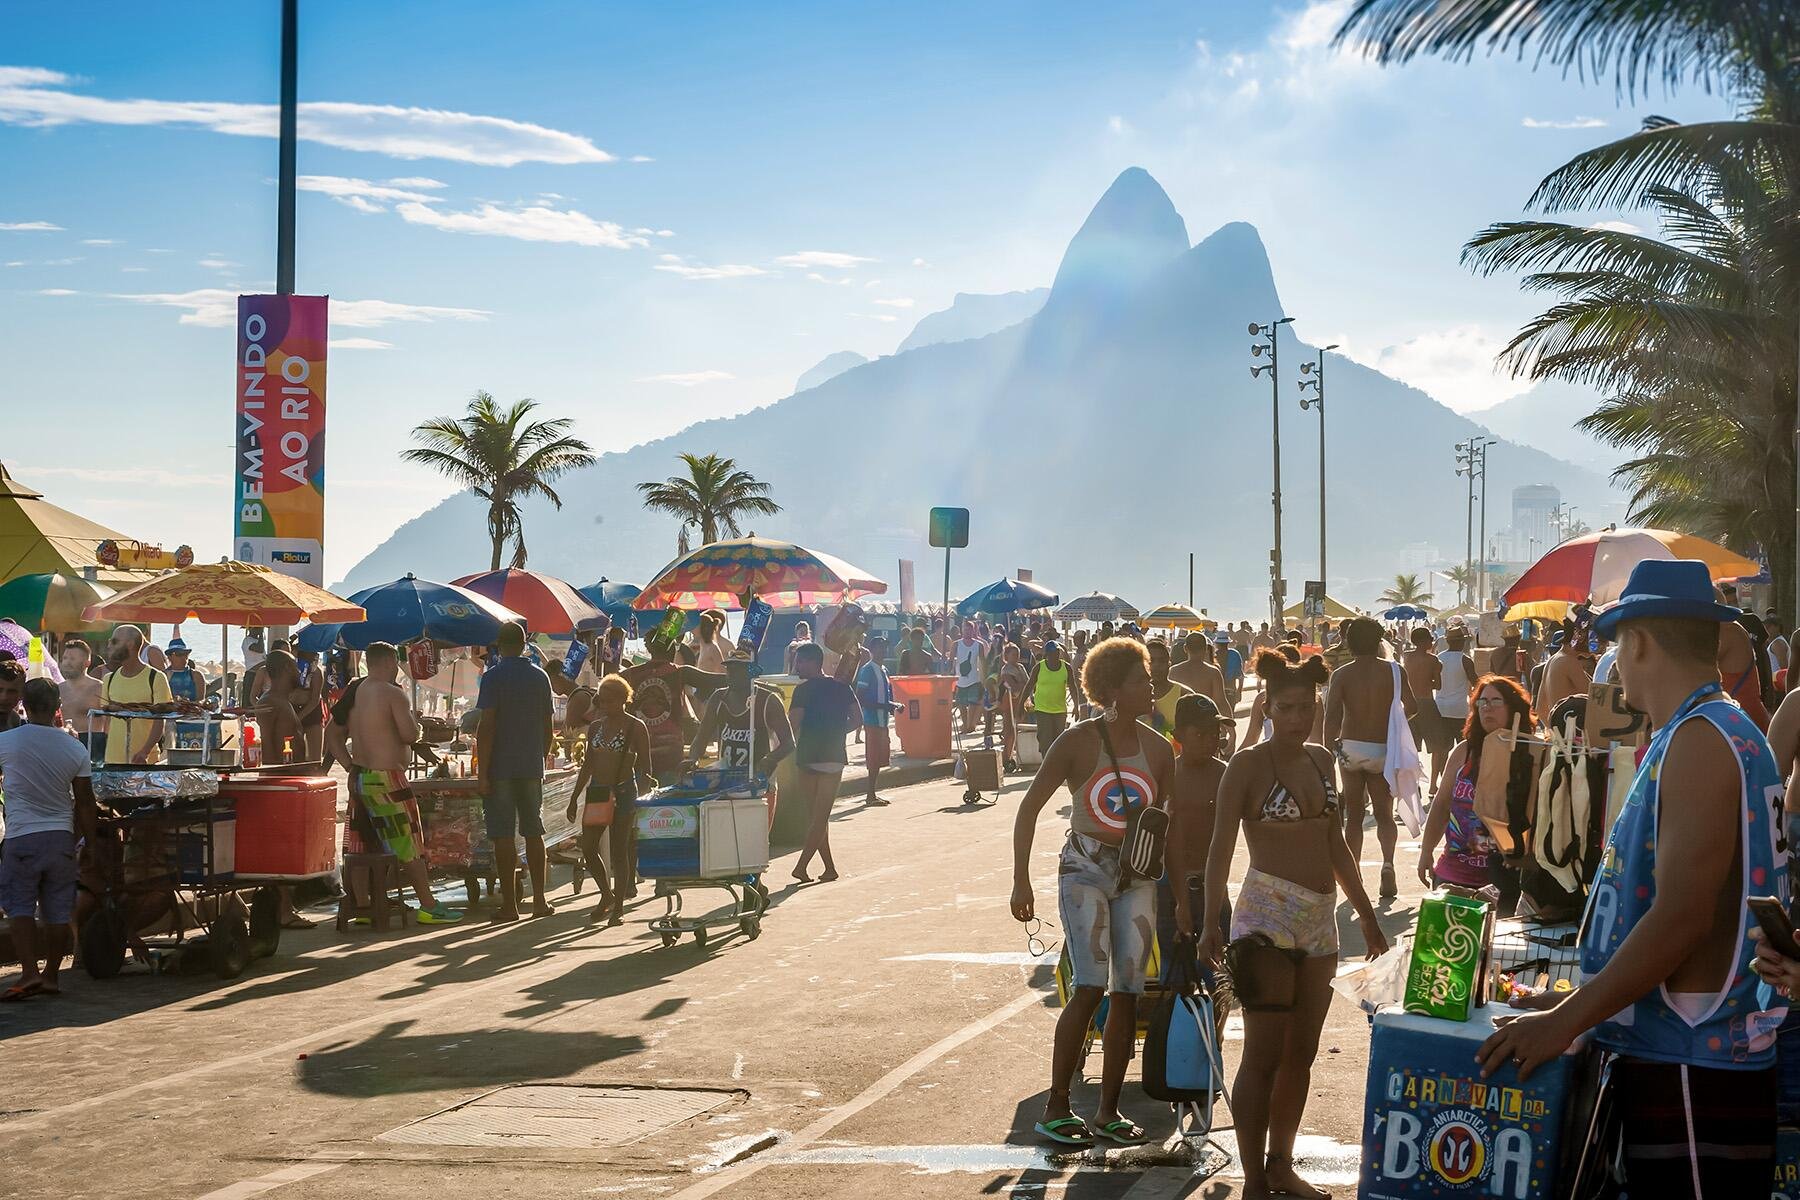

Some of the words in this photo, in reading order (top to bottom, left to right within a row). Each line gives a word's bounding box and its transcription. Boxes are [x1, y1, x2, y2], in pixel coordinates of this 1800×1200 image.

[280, 355, 310, 420] RIO
[241, 313, 267, 523] BEM-VINDO
[280, 430, 309, 485] AO
[282, 552, 311, 563] Riotur
[721, 723, 756, 743] LAKER
[649, 817, 686, 830] GUARACAMP
[1417, 965, 1434, 1000] BEATS
[1430, 963, 1451, 1007] SKOL
[1388, 1073, 1522, 1121] CARNAVAL
[1524, 1100, 1545, 1117] DA
[1433, 1109, 1488, 1137] ANTARCTICA
